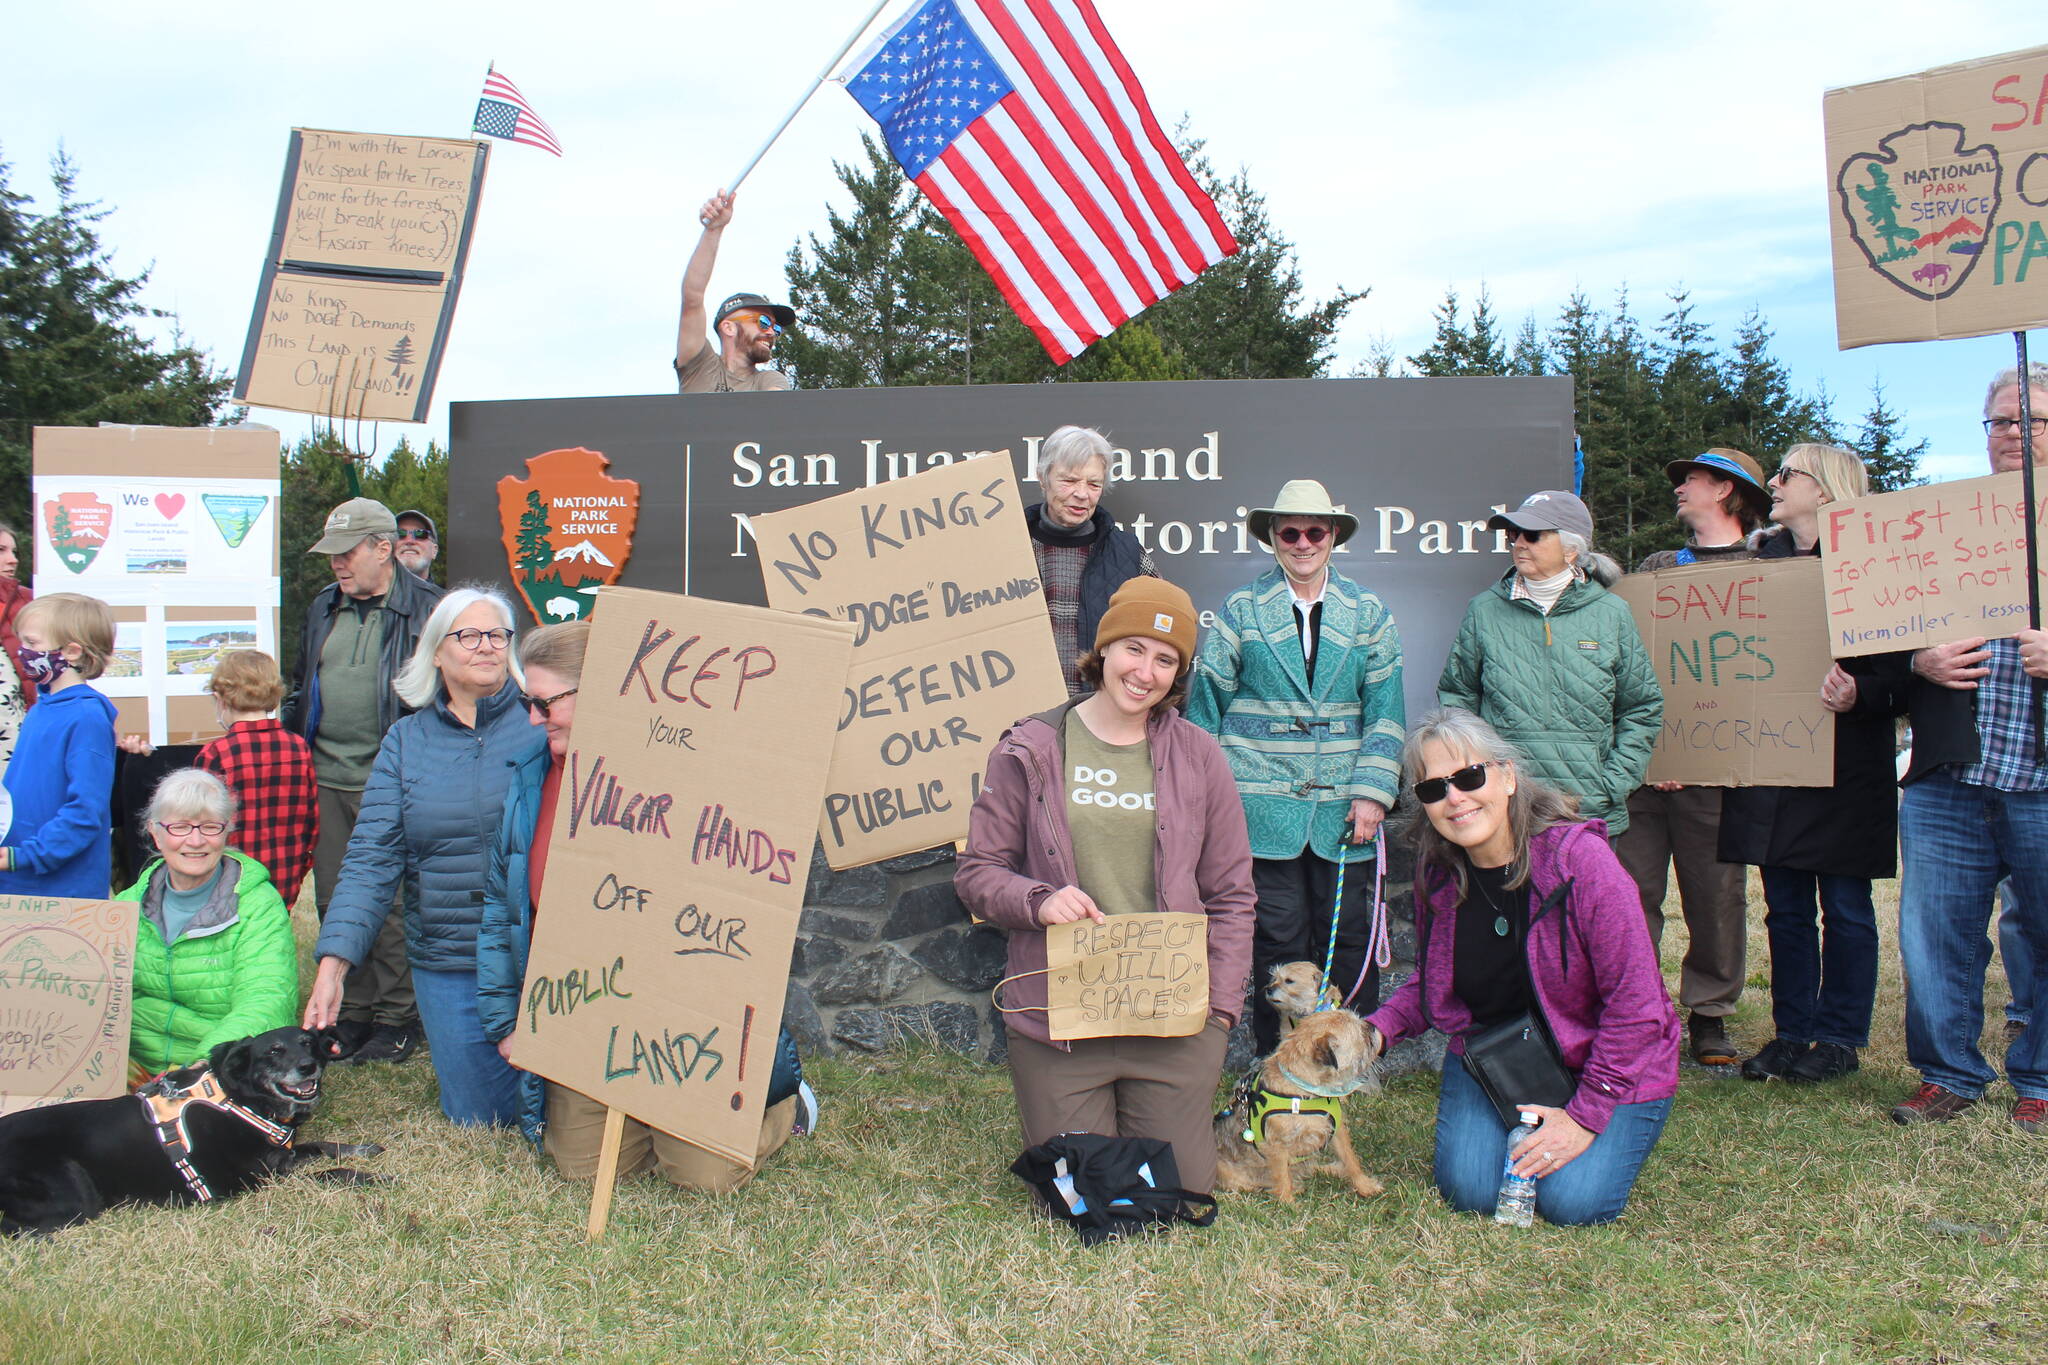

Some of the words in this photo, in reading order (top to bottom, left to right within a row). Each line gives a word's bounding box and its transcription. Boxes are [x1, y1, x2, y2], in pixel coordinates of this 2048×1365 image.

[348, 137, 379, 153] with
[383, 137, 408, 155] the
[303, 152, 325, 177] We
[330, 162, 371, 184] speak
[375, 160, 393, 183] for
[393, 166, 417, 184] the
[1903, 161, 1997, 186] NATIONAL
[296, 181, 337, 202] Come
[340, 187, 359, 204] for
[362, 189, 386, 207] the
[1922, 182, 1968, 199] PARK
[334, 207, 385, 230] break
[1910, 196, 1990, 222] SERVICE
[273, 286, 293, 304] No
[307, 289, 347, 312] Kings
[270, 310, 289, 323] No
[303, 309, 343, 327] DOGE
[350, 310, 416, 333] Demands
[307, 334, 351, 357] LAND
[731, 440, 840, 488] San
[1021, 431, 1223, 482] Iand
[122, 493, 149, 506] We
[553, 496, 628, 508] NATIONAL
[571, 510, 609, 521] PARK
[561, 523, 619, 535] SERVICE
[773, 530, 838, 596] NO
[861, 478, 1006, 559] KINGS
[1829, 500, 1951, 553] First
[1833, 556, 1877, 585] for
[1886, 546, 1939, 575] the
[941, 577, 1041, 618] DEMANDS
[1650, 576, 1767, 623] SAVE
[1831, 586, 1855, 616] I
[1873, 578, 1942, 608] was
[1957, 560, 2012, 591] not
[1842, 612, 1955, 647] Niemöller
[619, 619, 777, 712] KEEP
[1670, 630, 1776, 687] NPS
[1692, 700, 1718, 712] AND
[646, 715, 697, 751] YOUR
[880, 715, 982, 767] OUR
[1073, 765, 1118, 787] DO
[568, 750, 673, 840] VULGAR
[691, 803, 796, 885] HANDS
[824, 778, 952, 848] PUBLIC
[18, 897, 61, 913] NHP
[592, 872, 654, 913] OFF
[674, 903, 752, 957] OUR
[1073, 919, 1204, 956] RESPECT
[19, 957, 107, 1007] PARKS!
[1078, 951, 1193, 987] WILD
[527, 955, 633, 1035] PUBLIC
[1079, 982, 1192, 1022] SPACES
[85, 1050, 104, 1082] NP
